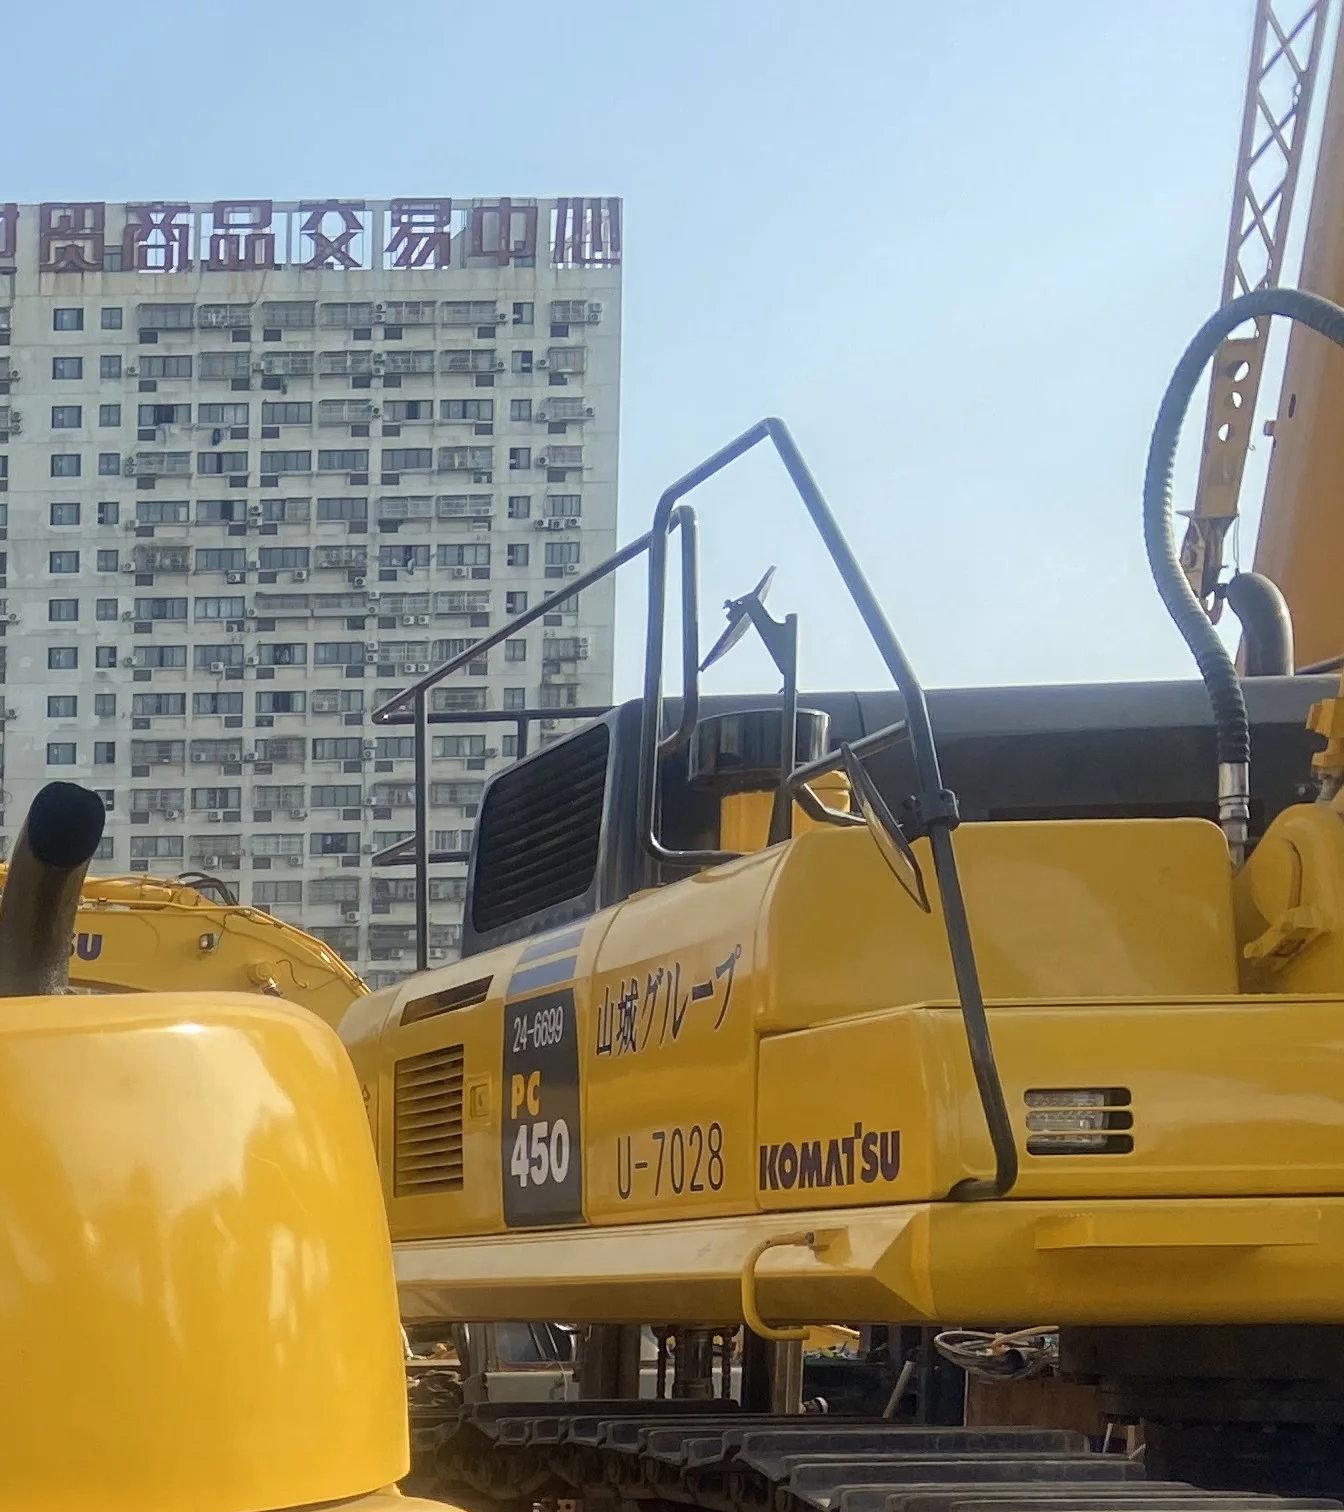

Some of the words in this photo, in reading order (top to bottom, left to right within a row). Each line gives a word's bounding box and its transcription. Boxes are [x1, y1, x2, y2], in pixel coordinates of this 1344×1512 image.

[513, 1006, 563, 1053] 24-6699
[511, 1070, 541, 1119] PC
[511, 1118, 569, 1188] 450
[617, 1122, 724, 1199] U-7028
[759, 1121, 901, 1191] KOMATSU
